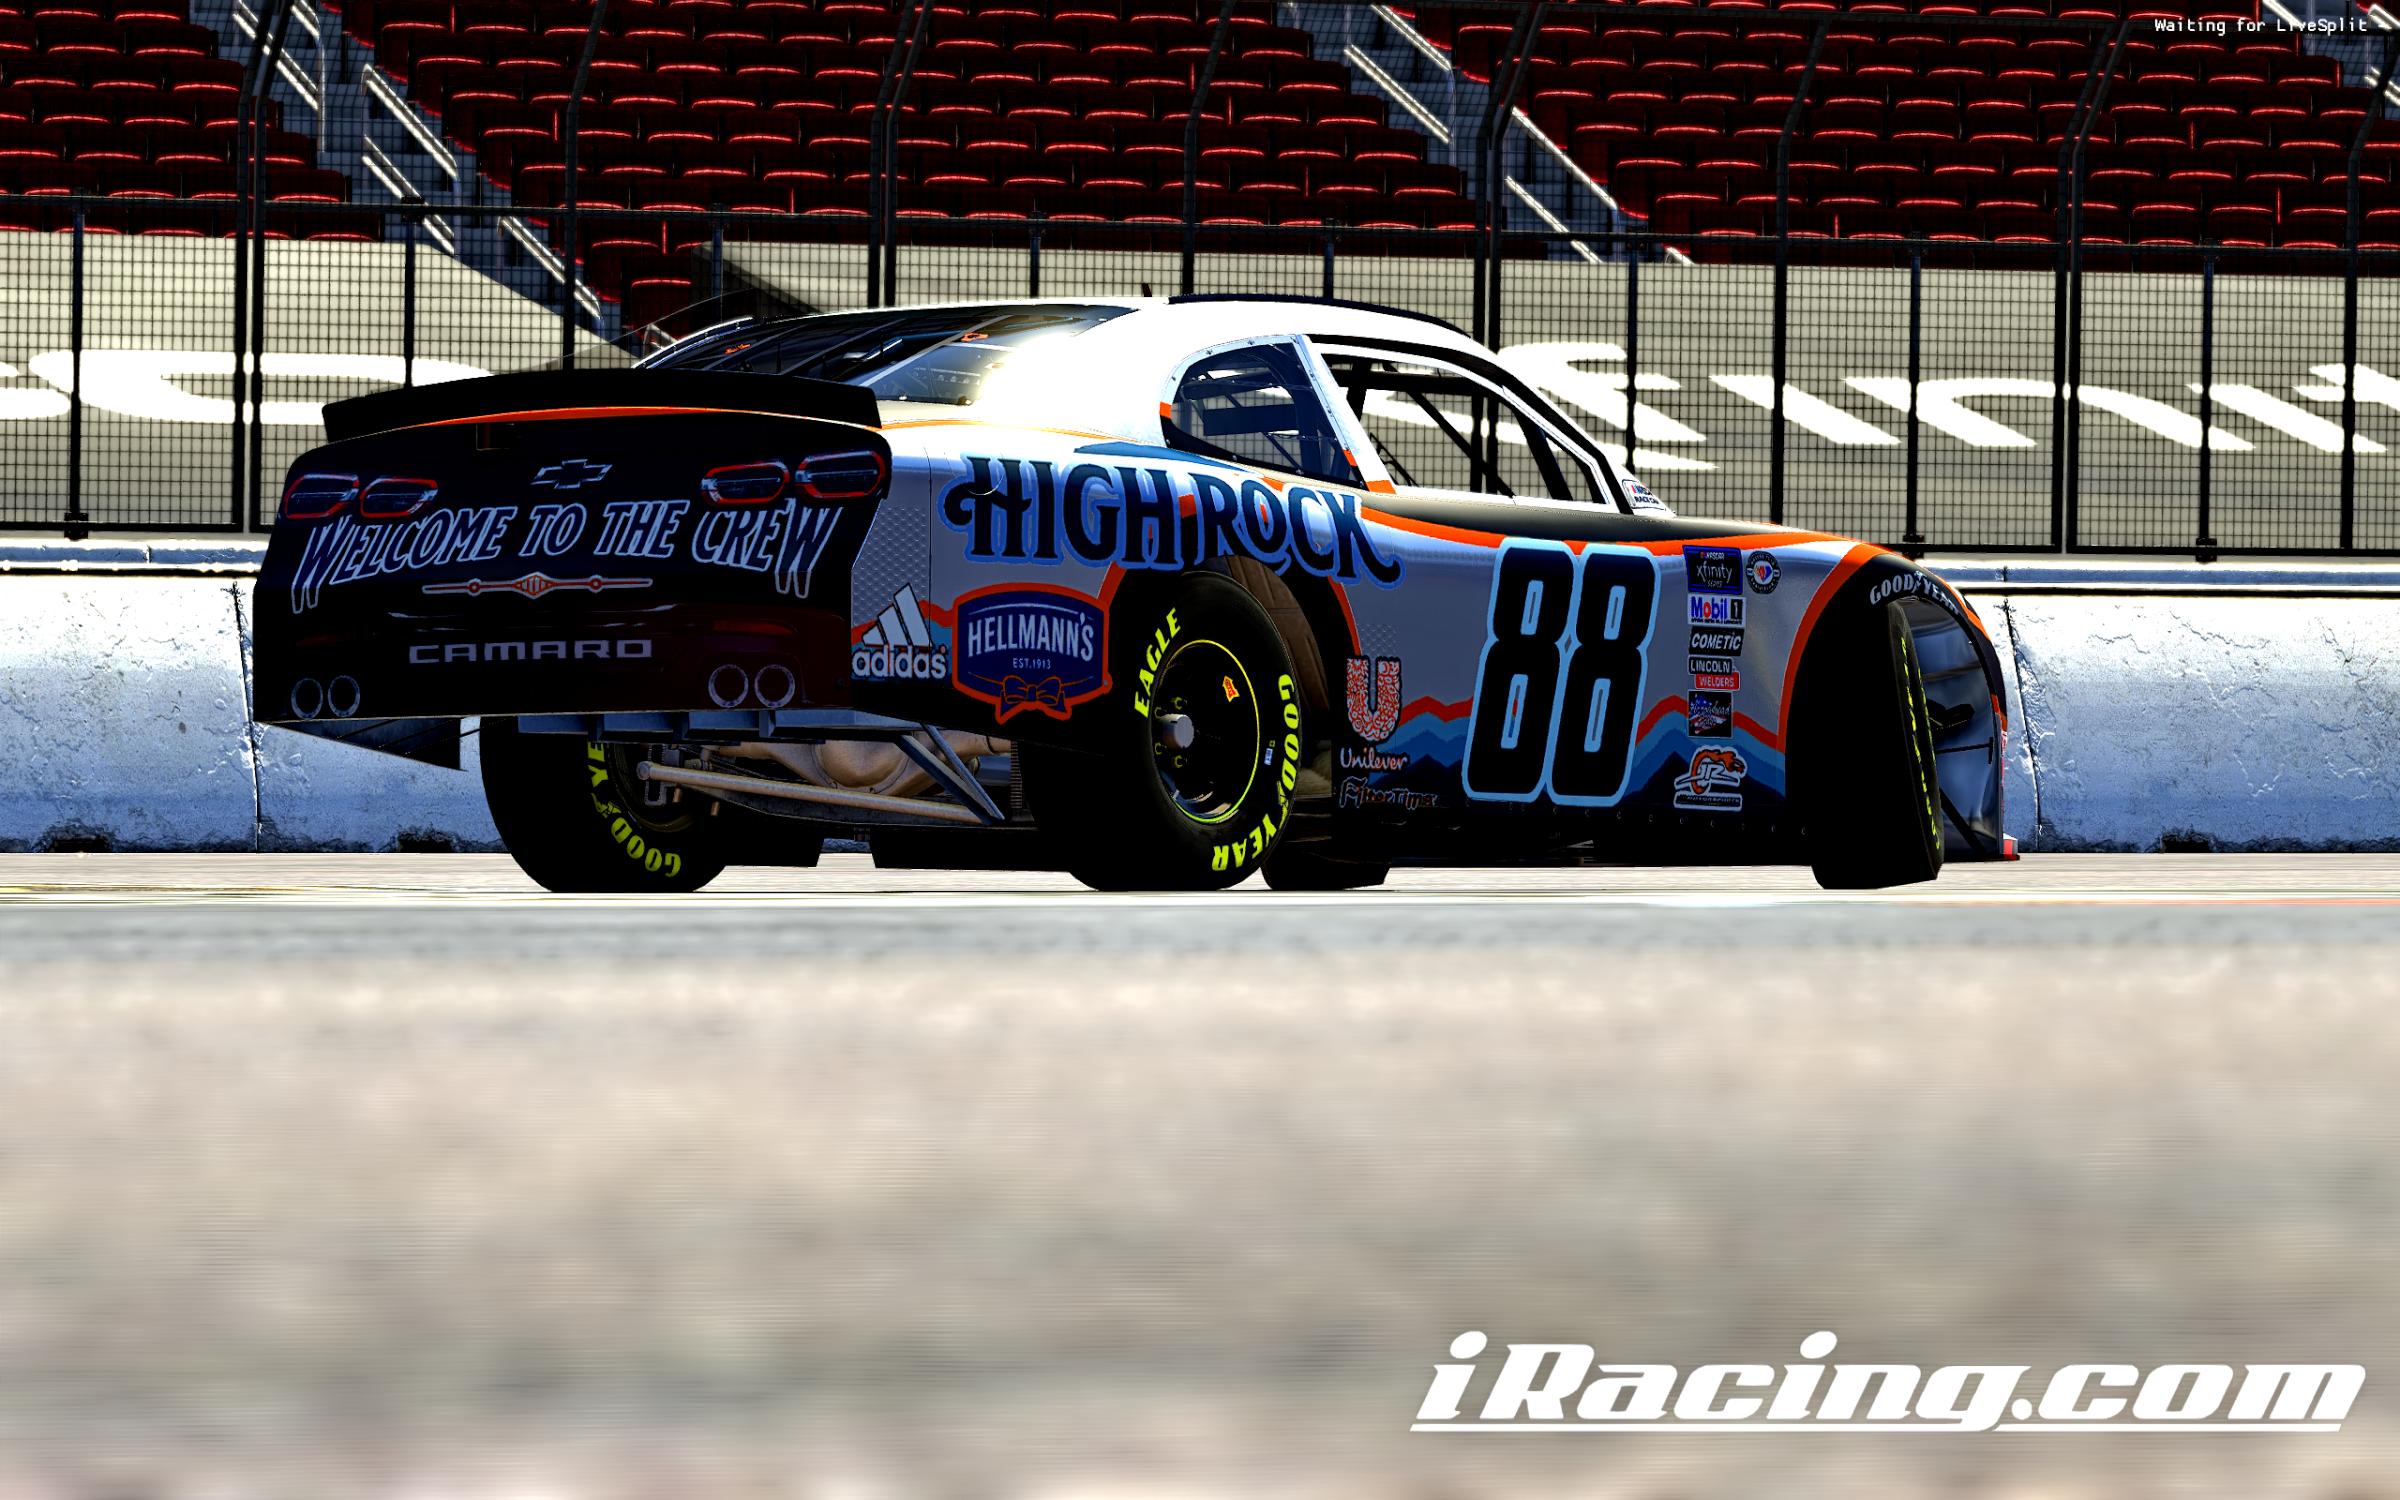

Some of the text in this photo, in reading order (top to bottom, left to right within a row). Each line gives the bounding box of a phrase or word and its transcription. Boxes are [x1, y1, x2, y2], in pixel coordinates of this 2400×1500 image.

[940, 452, 1407, 588] HIGH ROCK
[292, 497, 843, 614] WELCOME TO THE CREW
[1696, 560, 1733, 583] xfinity
[1691, 596, 1728, 619] Mobil
[1870, 571, 1960, 615] GOODYEAR
[409, 639, 652, 664] CAMARO
[967, 612, 1095, 662] HELLMANN'S
[1691, 632, 1742, 651] COMETIC
[851, 644, 947, 679] adidas
[1134, 608, 1181, 718] EAGLE
[1461, 537, 1661, 807] 88
[1690, 659, 1731, 673] LINCOLN
[1699, 676, 1735, 688] WELDERS
[1211, 674, 1300, 871] GOODYEAR
[1340, 747, 1408, 770] Unilever
[587, 741, 681, 877] GOODYE
